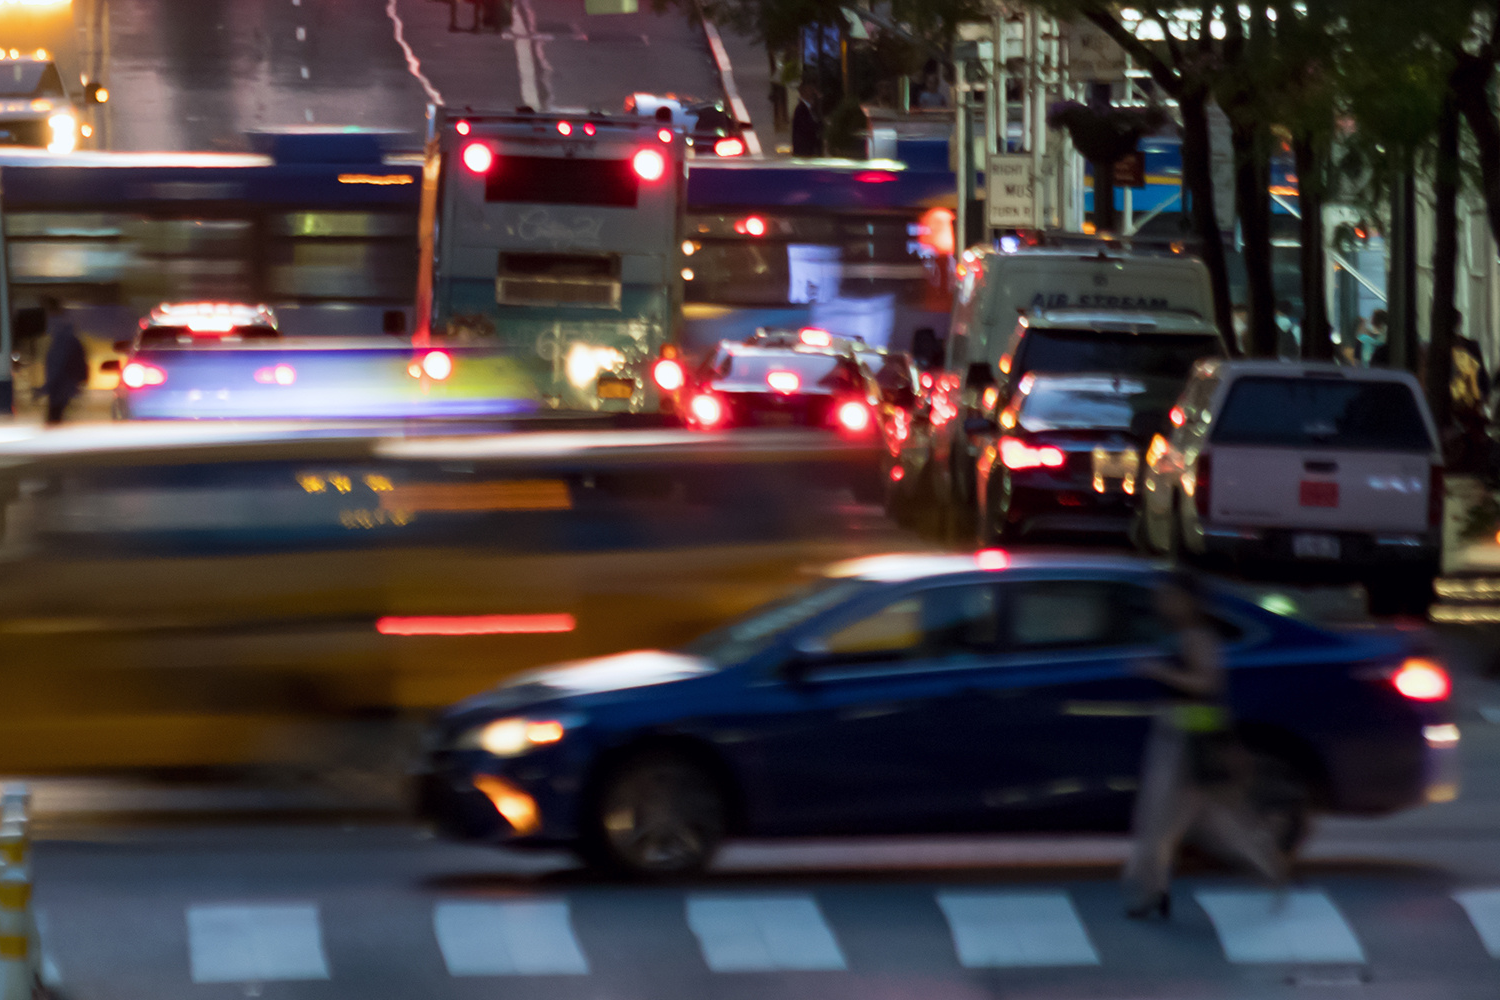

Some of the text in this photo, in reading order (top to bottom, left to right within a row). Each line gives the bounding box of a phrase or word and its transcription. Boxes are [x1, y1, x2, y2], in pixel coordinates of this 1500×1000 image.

[992, 165, 1023, 176] RIGHT
[992, 206, 1019, 217] TURN
[1032, 293, 1169, 309] AIR STREAM
